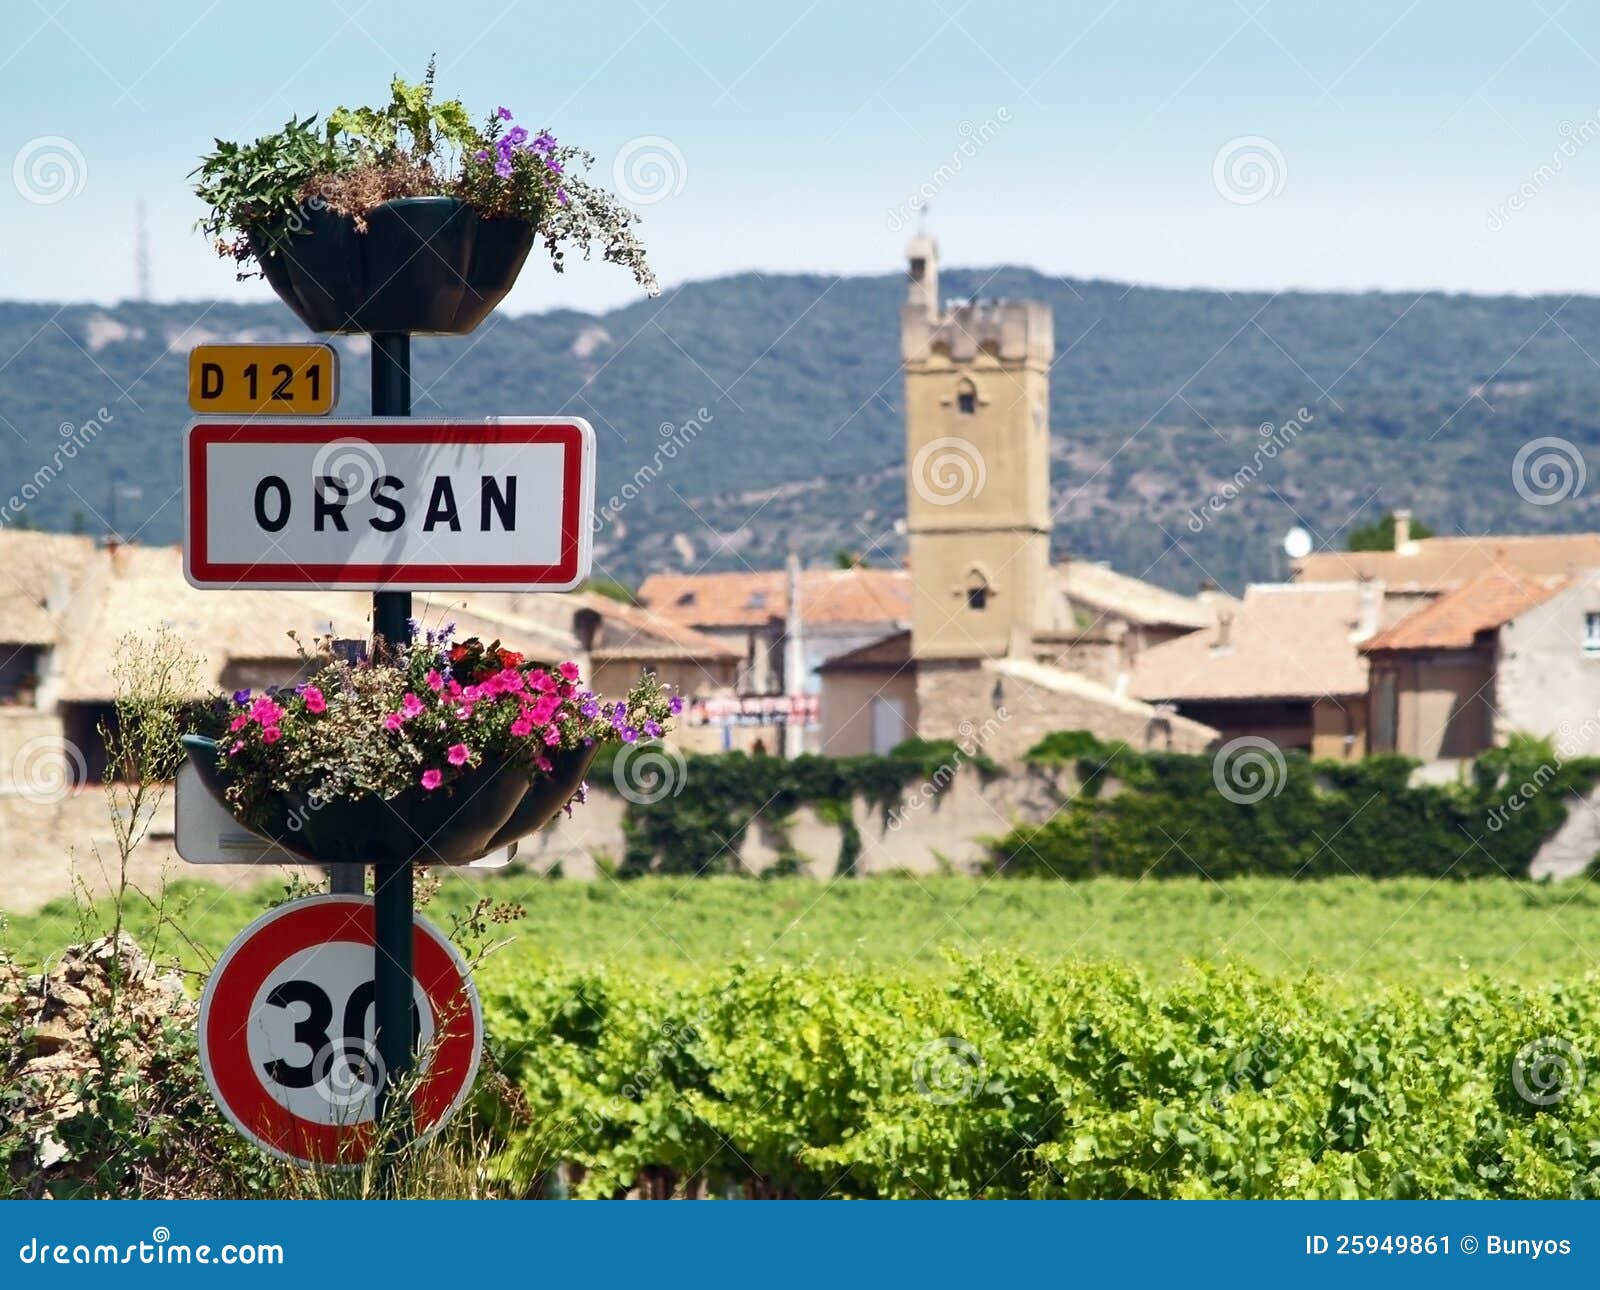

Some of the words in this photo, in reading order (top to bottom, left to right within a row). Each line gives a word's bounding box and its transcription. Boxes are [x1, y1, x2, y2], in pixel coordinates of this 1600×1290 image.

[201, 363, 224, 399] D
[243, 364, 320, 400] 121
[254, 475, 517, 532] ORSAN
